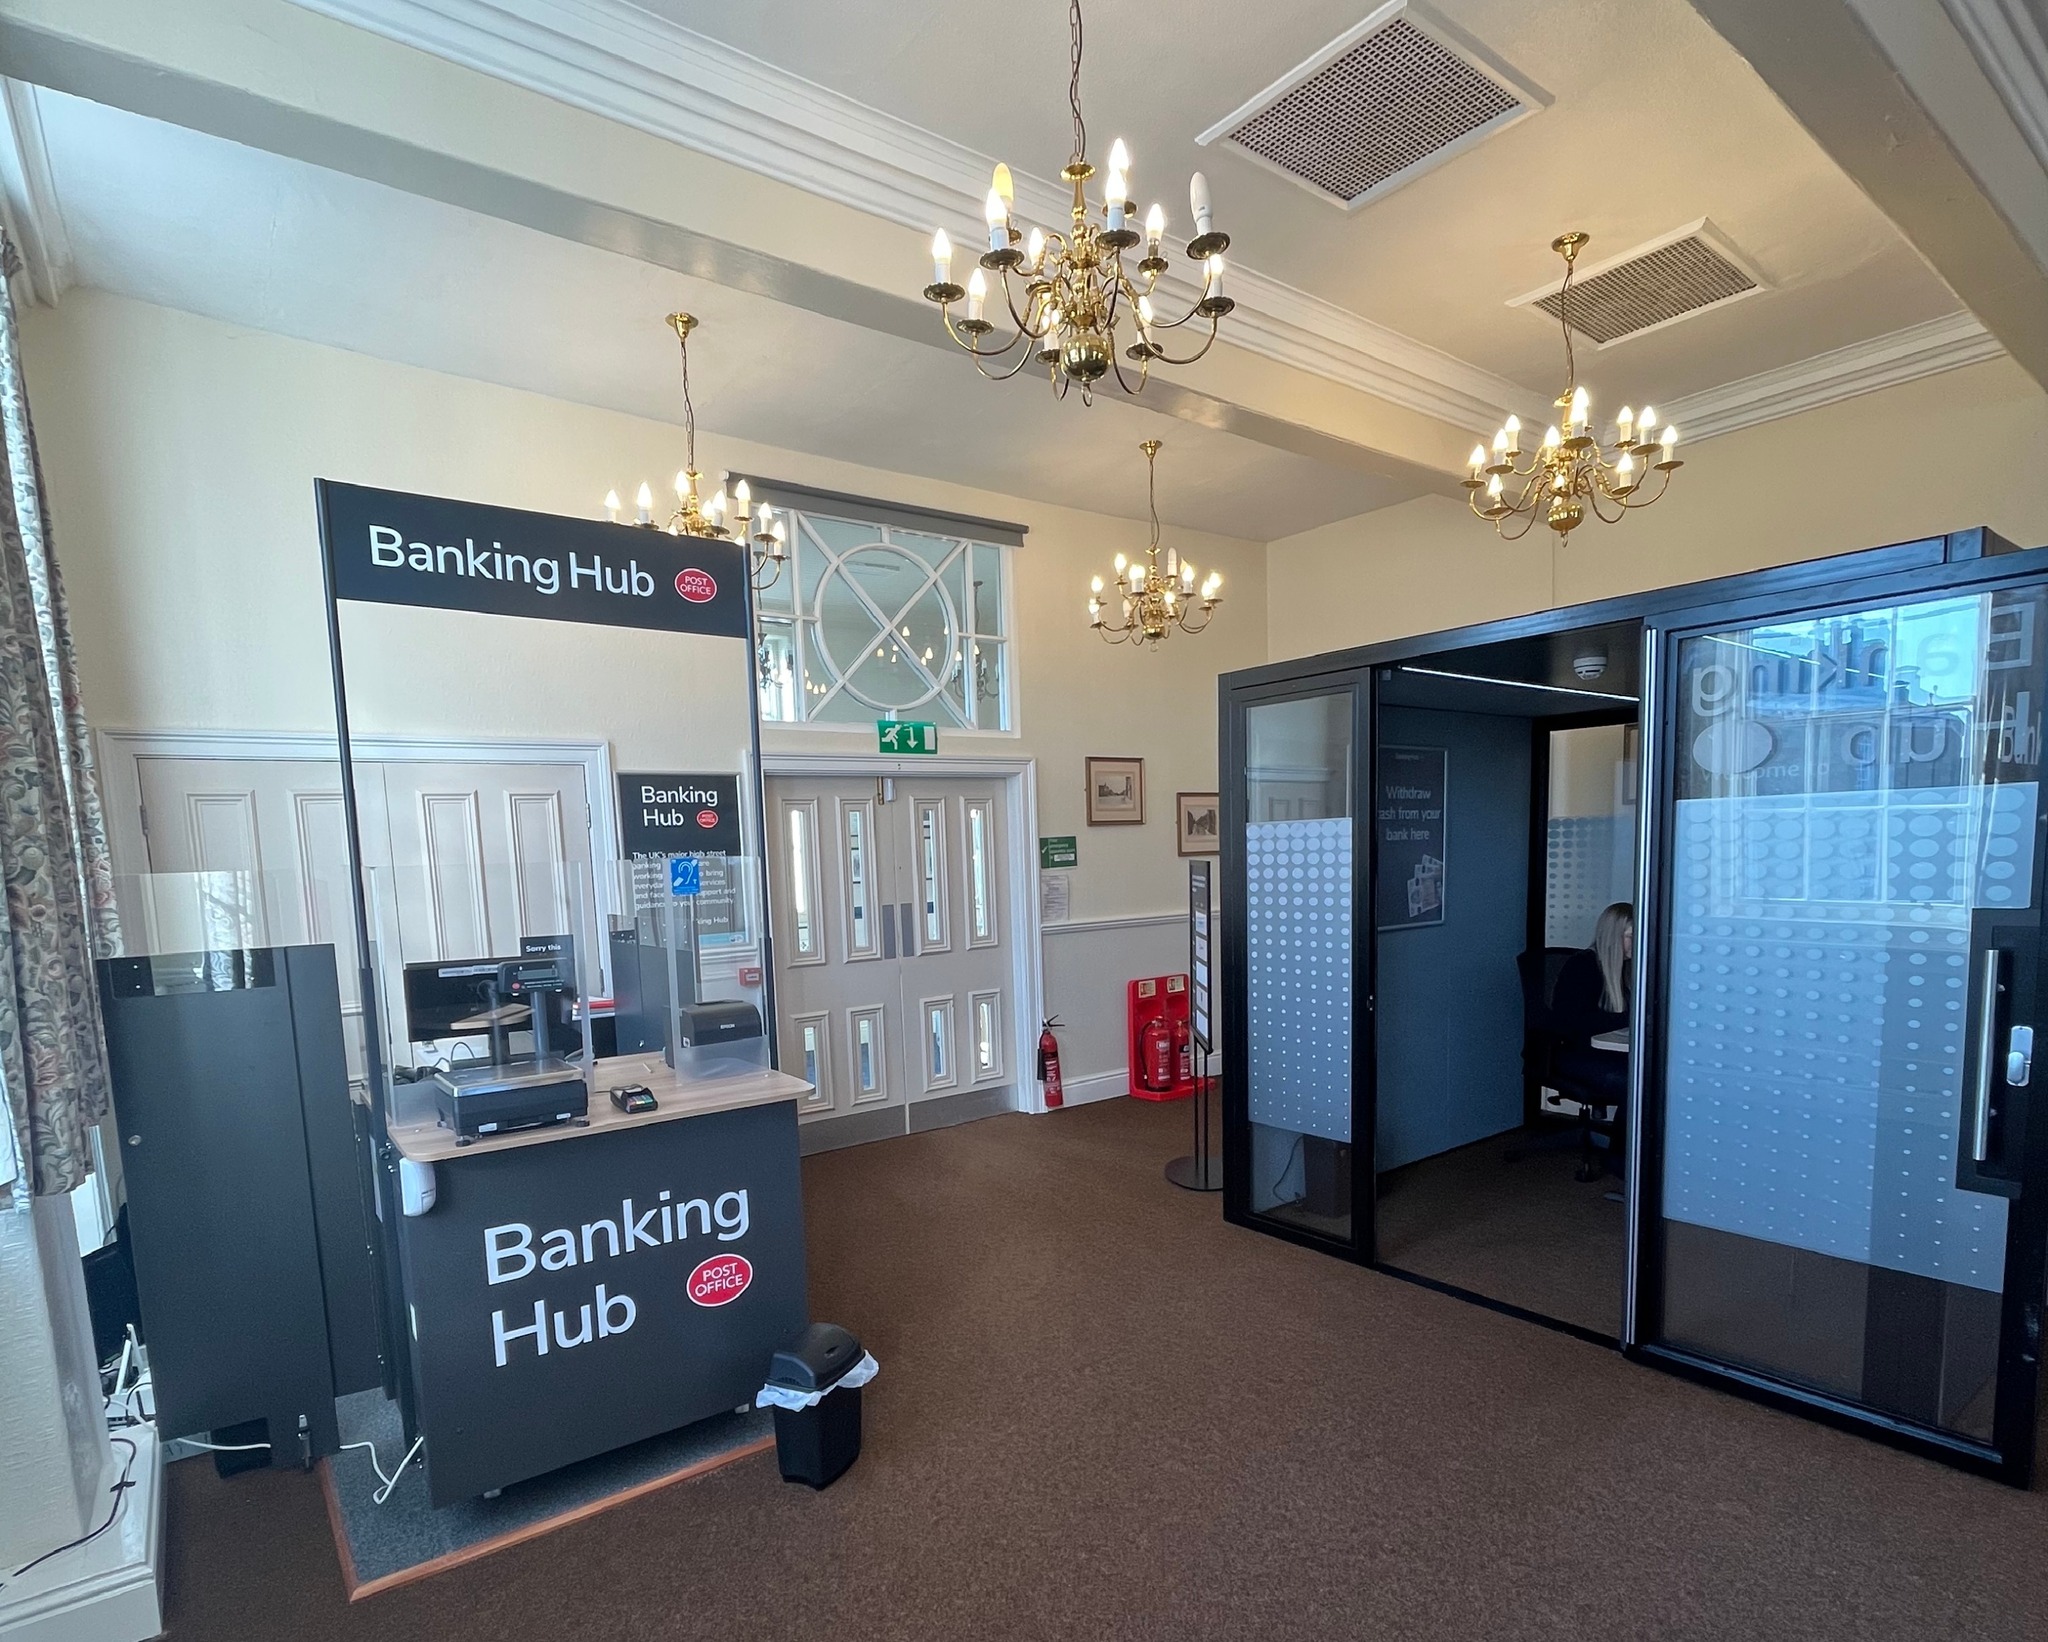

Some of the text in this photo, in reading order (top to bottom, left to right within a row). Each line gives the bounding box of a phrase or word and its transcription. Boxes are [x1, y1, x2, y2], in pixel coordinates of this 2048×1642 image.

[369, 524, 655, 597] Banking Hub
[685, 575, 708, 586] POST
[680, 583, 711, 595] OFFICE
[641, 785, 718, 807] Banking
[1385, 786, 1431, 799] Withdraw
[643, 808, 684, 827] Hub
[1398, 807, 1419, 820] from
[1421, 809, 1441, 822] your
[1386, 827, 1430, 841] bank here
[632, 849, 726, 860] The UK's major high street
[634, 882, 664, 890] everyda
[526, 945, 546, 953] Sorry
[484, 1189, 750, 1285] Banking
[702, 1262, 738, 1281] POST
[695, 1274, 744, 1297] OFFICE
[492, 1284, 637, 1367] Hub
